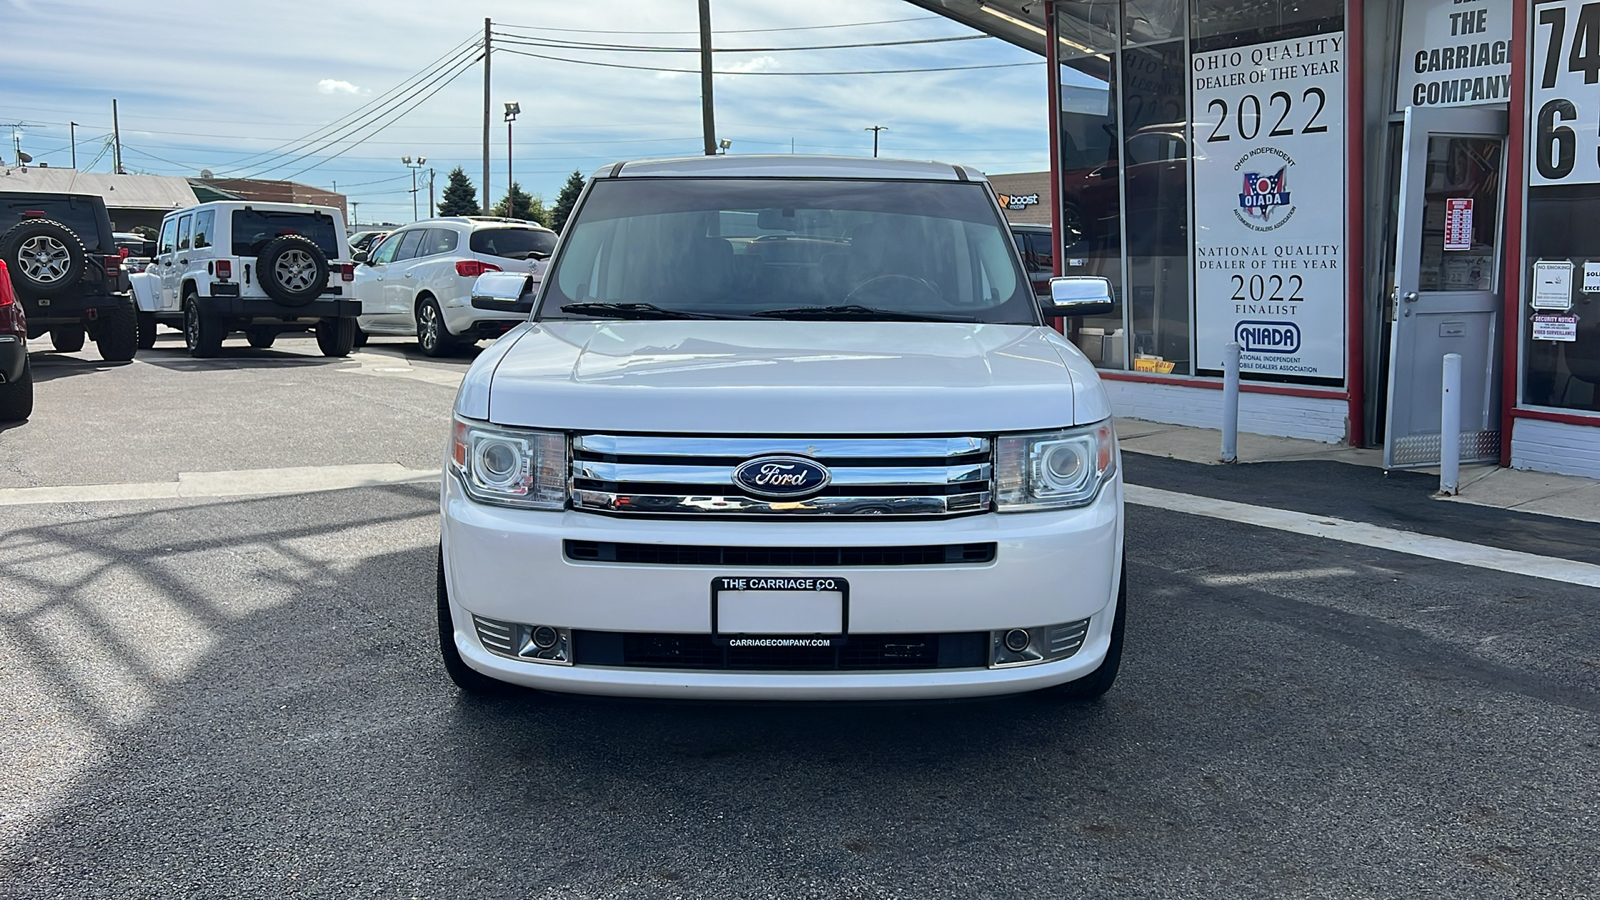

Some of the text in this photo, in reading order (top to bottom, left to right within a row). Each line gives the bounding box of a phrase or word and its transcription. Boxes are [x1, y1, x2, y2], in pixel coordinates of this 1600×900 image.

[1450, 9, 1487, 36] THE
[1194, 52, 1241, 71] OHIO
[1251, 37, 1342, 66] QUALITY
[1197, 60, 1340, 90] DEALER OF THE YEAR
[1412, 75, 1511, 106] COMPANY
[1207, 87, 1328, 142] 2022
[1234, 147, 1296, 171] OHIO INDEPENDENT
[1010, 193, 1038, 205] boost
[1245, 194, 1281, 206] OIADA
[1198, 245, 1339, 257] NATIONAL QUALITY
[1200, 259, 1338, 269] DEALER OF THE YEAR
[1231, 274, 1304, 301] 2022
[1235, 304, 1297, 314] FINALIST
[1279, 365, 1318, 373] ASSOCIATION
[755, 463, 808, 485] Ford
[722, 579, 837, 590] THE CARRIAGE CO.
[730, 639, 830, 647] CARRIAGECOMPANY.COM
